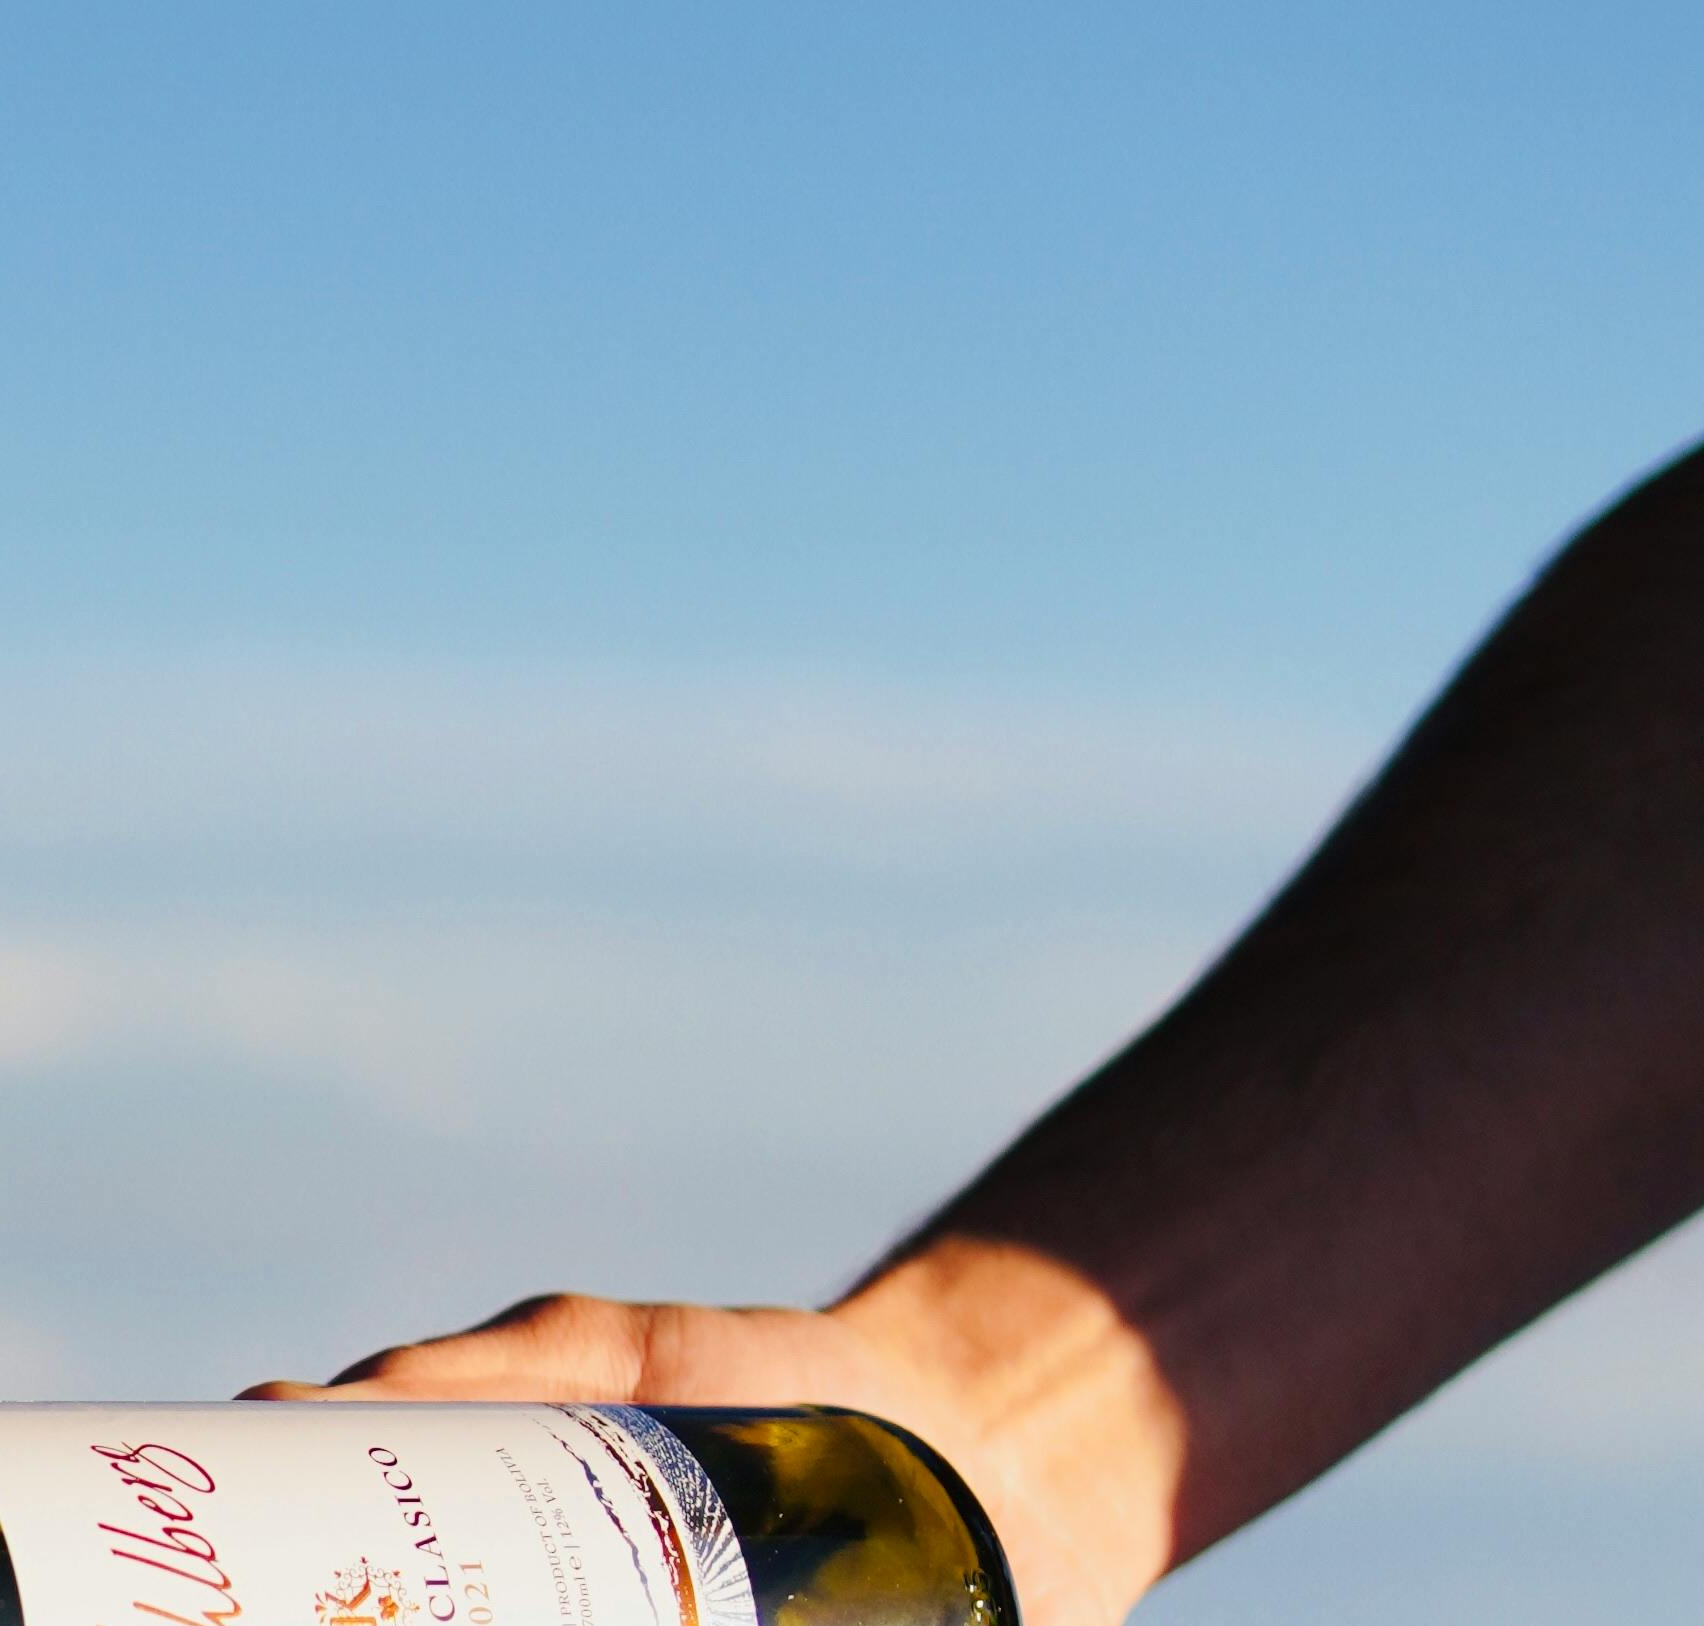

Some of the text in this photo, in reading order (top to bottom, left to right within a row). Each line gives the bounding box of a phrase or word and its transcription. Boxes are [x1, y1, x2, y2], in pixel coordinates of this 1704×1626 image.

[495, 1448, 537, 1502] BOLIVIA
[537, 1478, 557, 1503] Vol.
[368, 1447, 455, 1621] CLASICO
[530, 1506, 548, 1527] OF
[552, 1508, 573, 1537] 12%
[540, 1531, 572, 1616] PRODUCT
